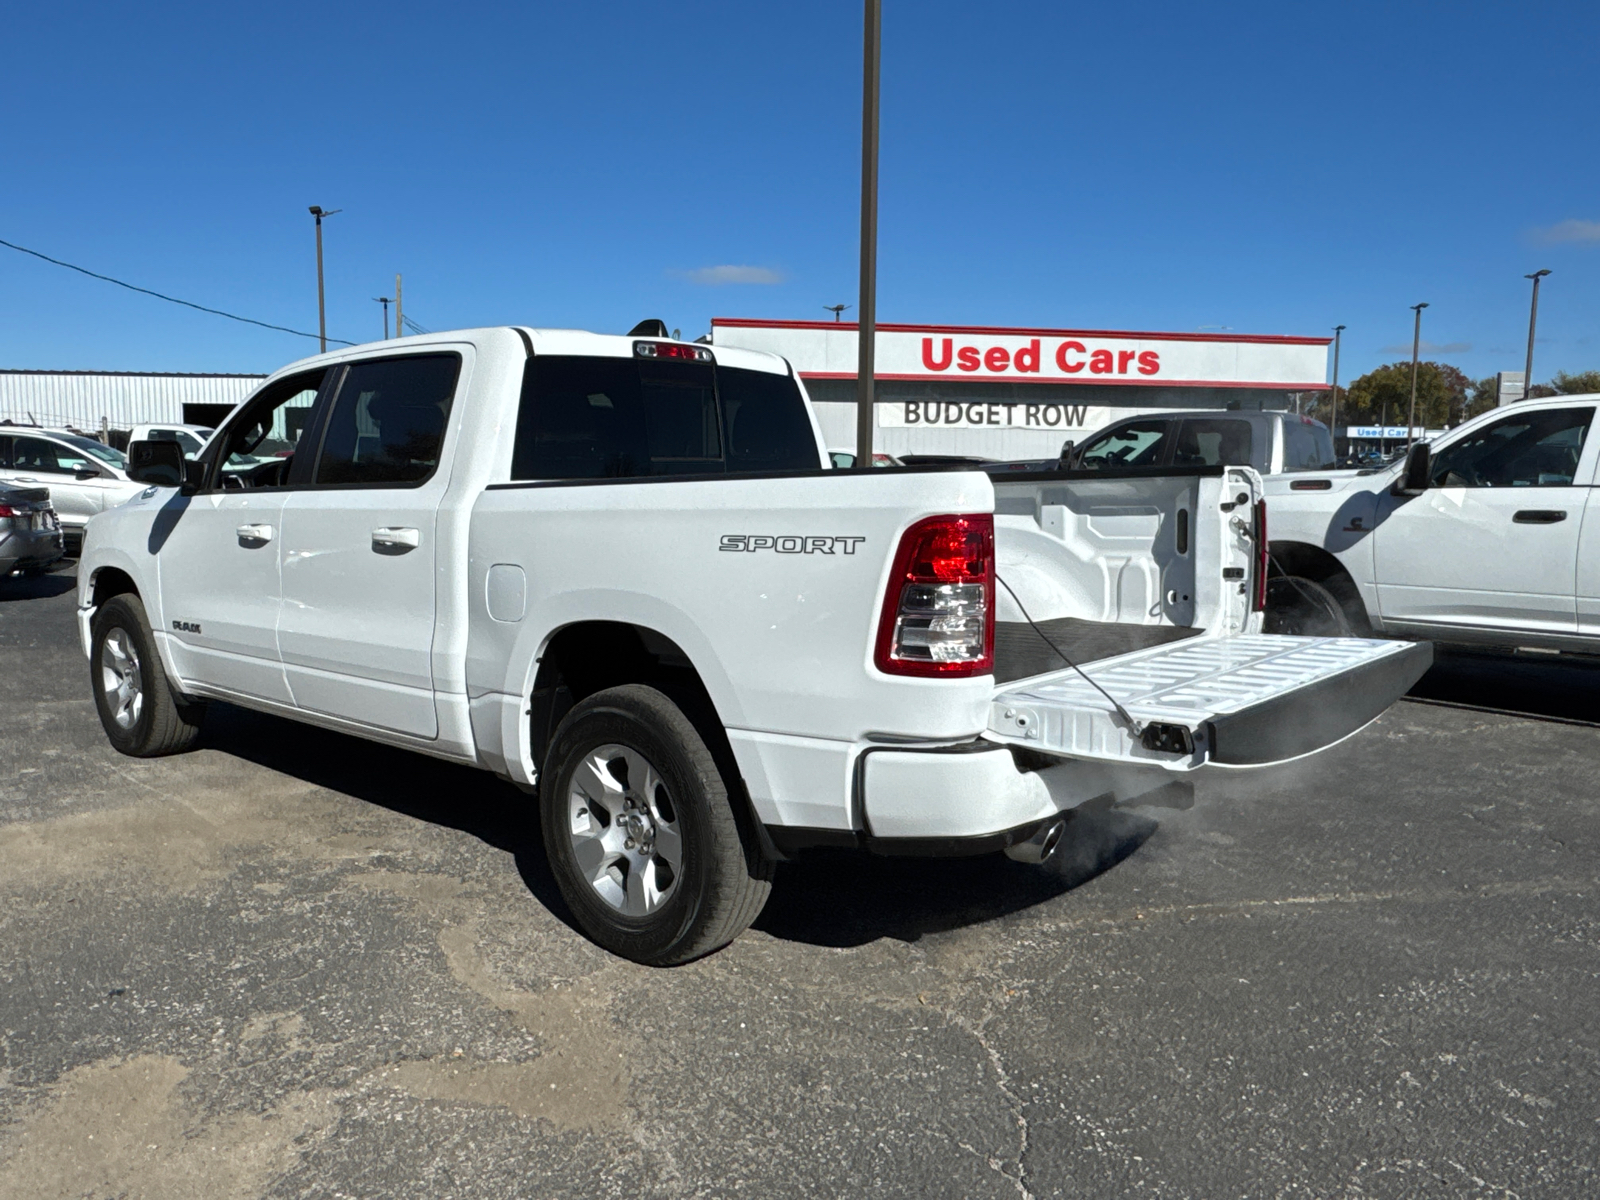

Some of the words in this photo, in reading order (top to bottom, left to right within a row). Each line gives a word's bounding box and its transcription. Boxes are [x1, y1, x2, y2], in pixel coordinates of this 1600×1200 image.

[922, 337, 1041, 373] Used
[1055, 340, 1160, 375] Cars
[904, 401, 1018, 425] BUDGET
[1025, 403, 1088, 427] ROW
[1357, 428, 1384, 437] Used
[1387, 428, 1410, 437] Car
[719, 535, 866, 554] SPORT
